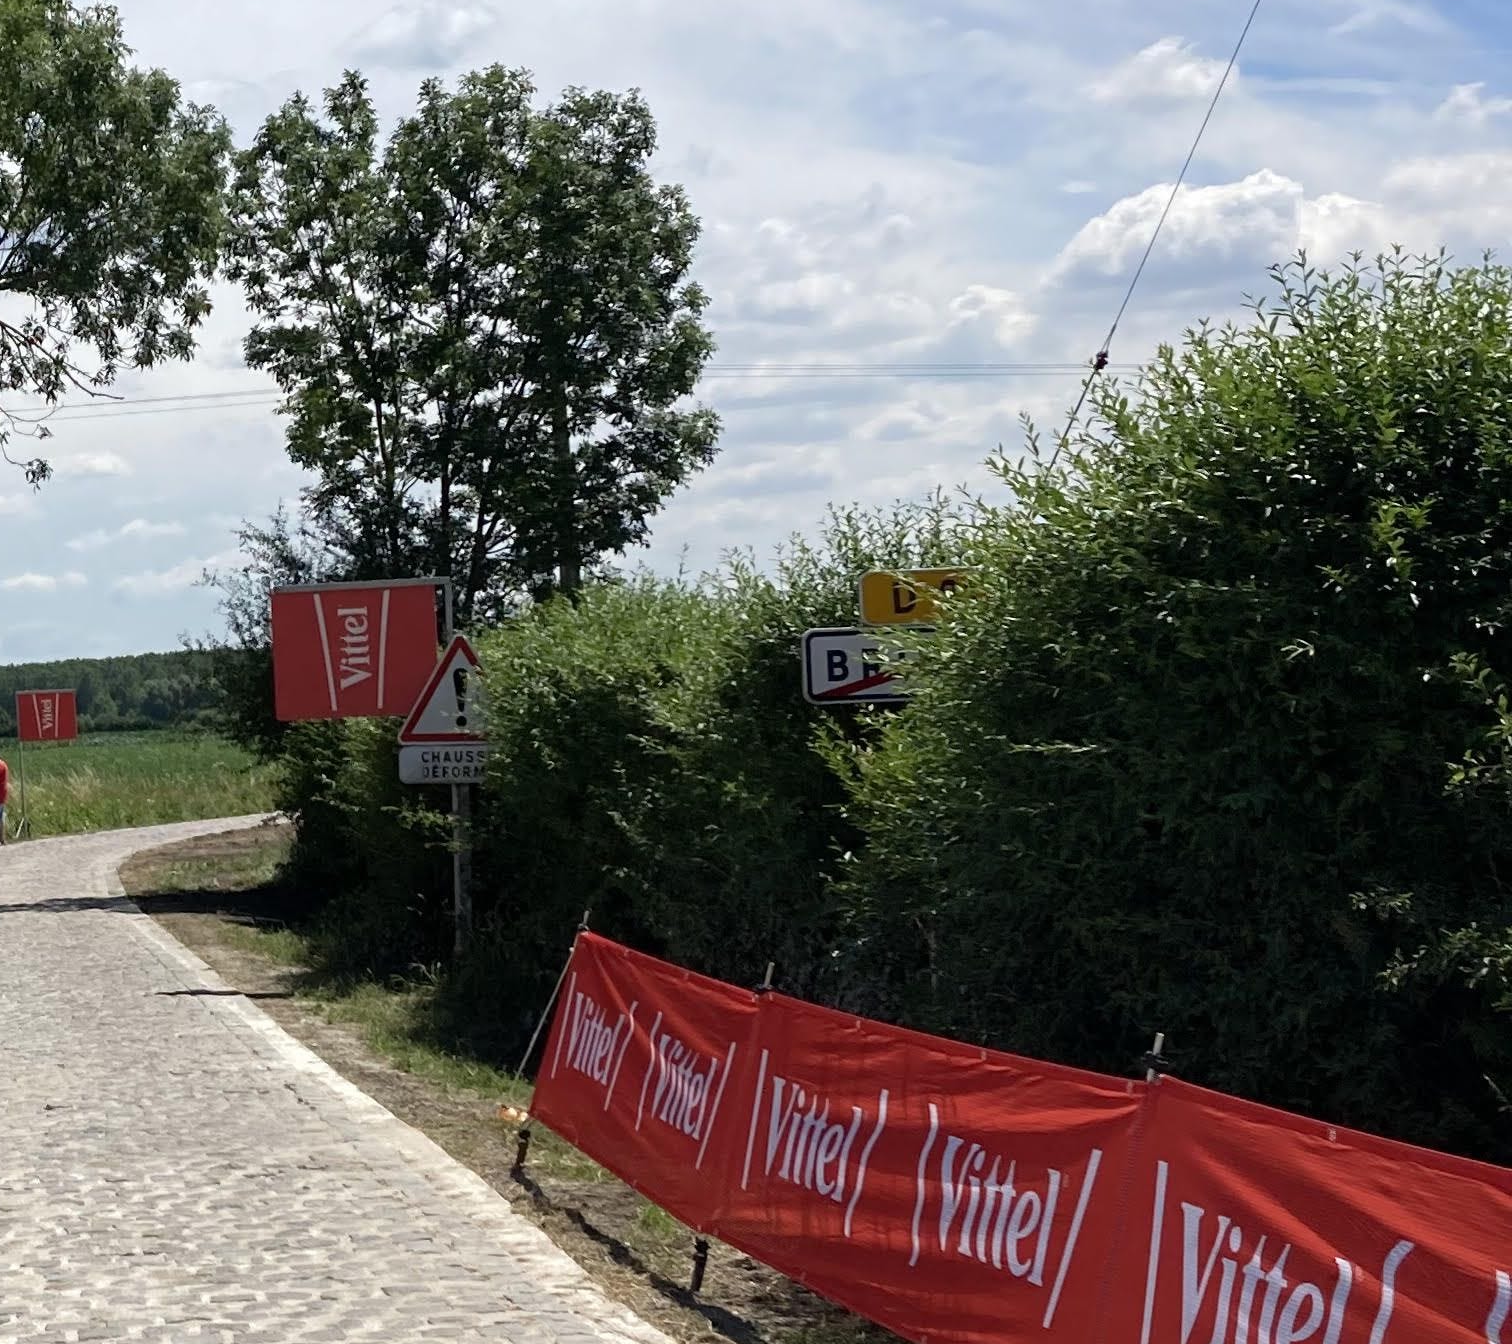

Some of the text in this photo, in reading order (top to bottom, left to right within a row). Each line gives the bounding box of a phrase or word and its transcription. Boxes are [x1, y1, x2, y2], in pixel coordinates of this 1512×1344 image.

[338, 605, 373, 690] Vittel
[565, 991, 626, 1087] Vittel
[651, 1033, 717, 1140] Vittel
[764, 1076, 864, 1202] Vittel
[939, 1135, 1061, 1287] Vittel
